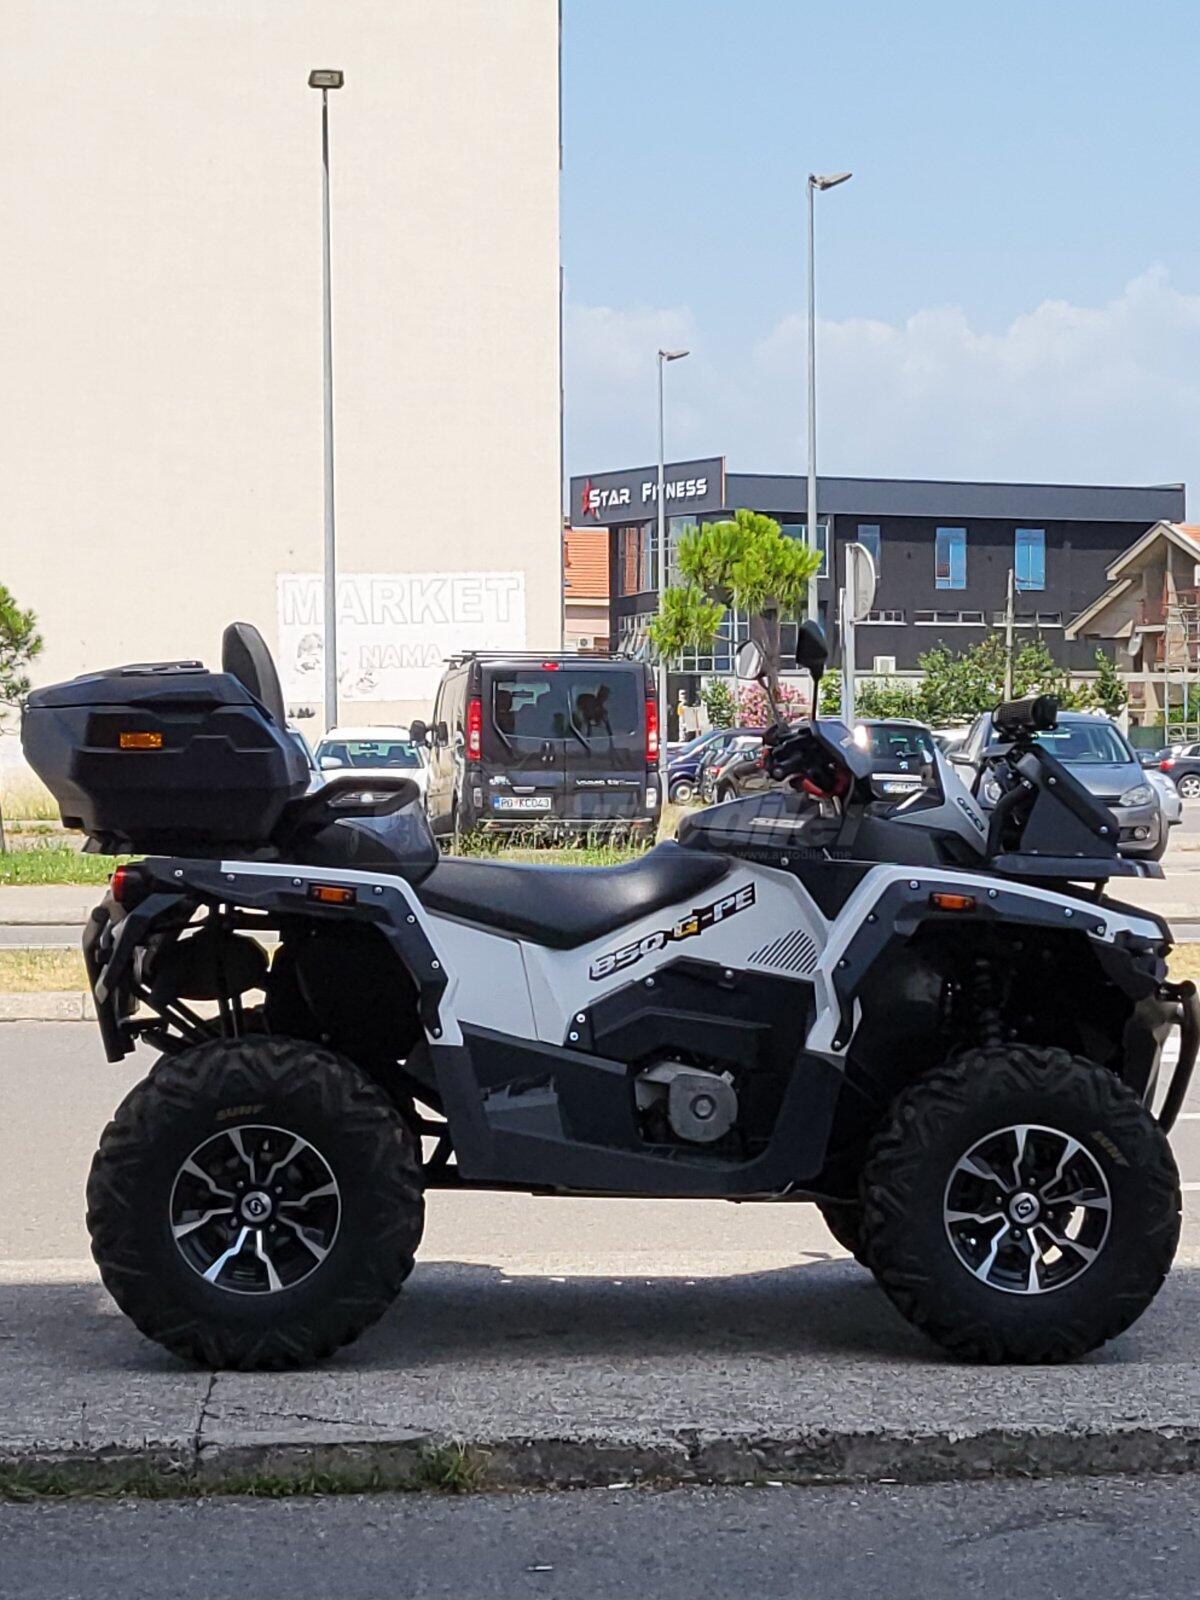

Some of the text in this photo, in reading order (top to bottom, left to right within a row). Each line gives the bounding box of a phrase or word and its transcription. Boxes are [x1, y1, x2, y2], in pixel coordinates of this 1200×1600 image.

[588, 488, 631, 508] STAR
[282, 577, 519, 625] MARKET
[359, 643, 443, 668] NAMA
